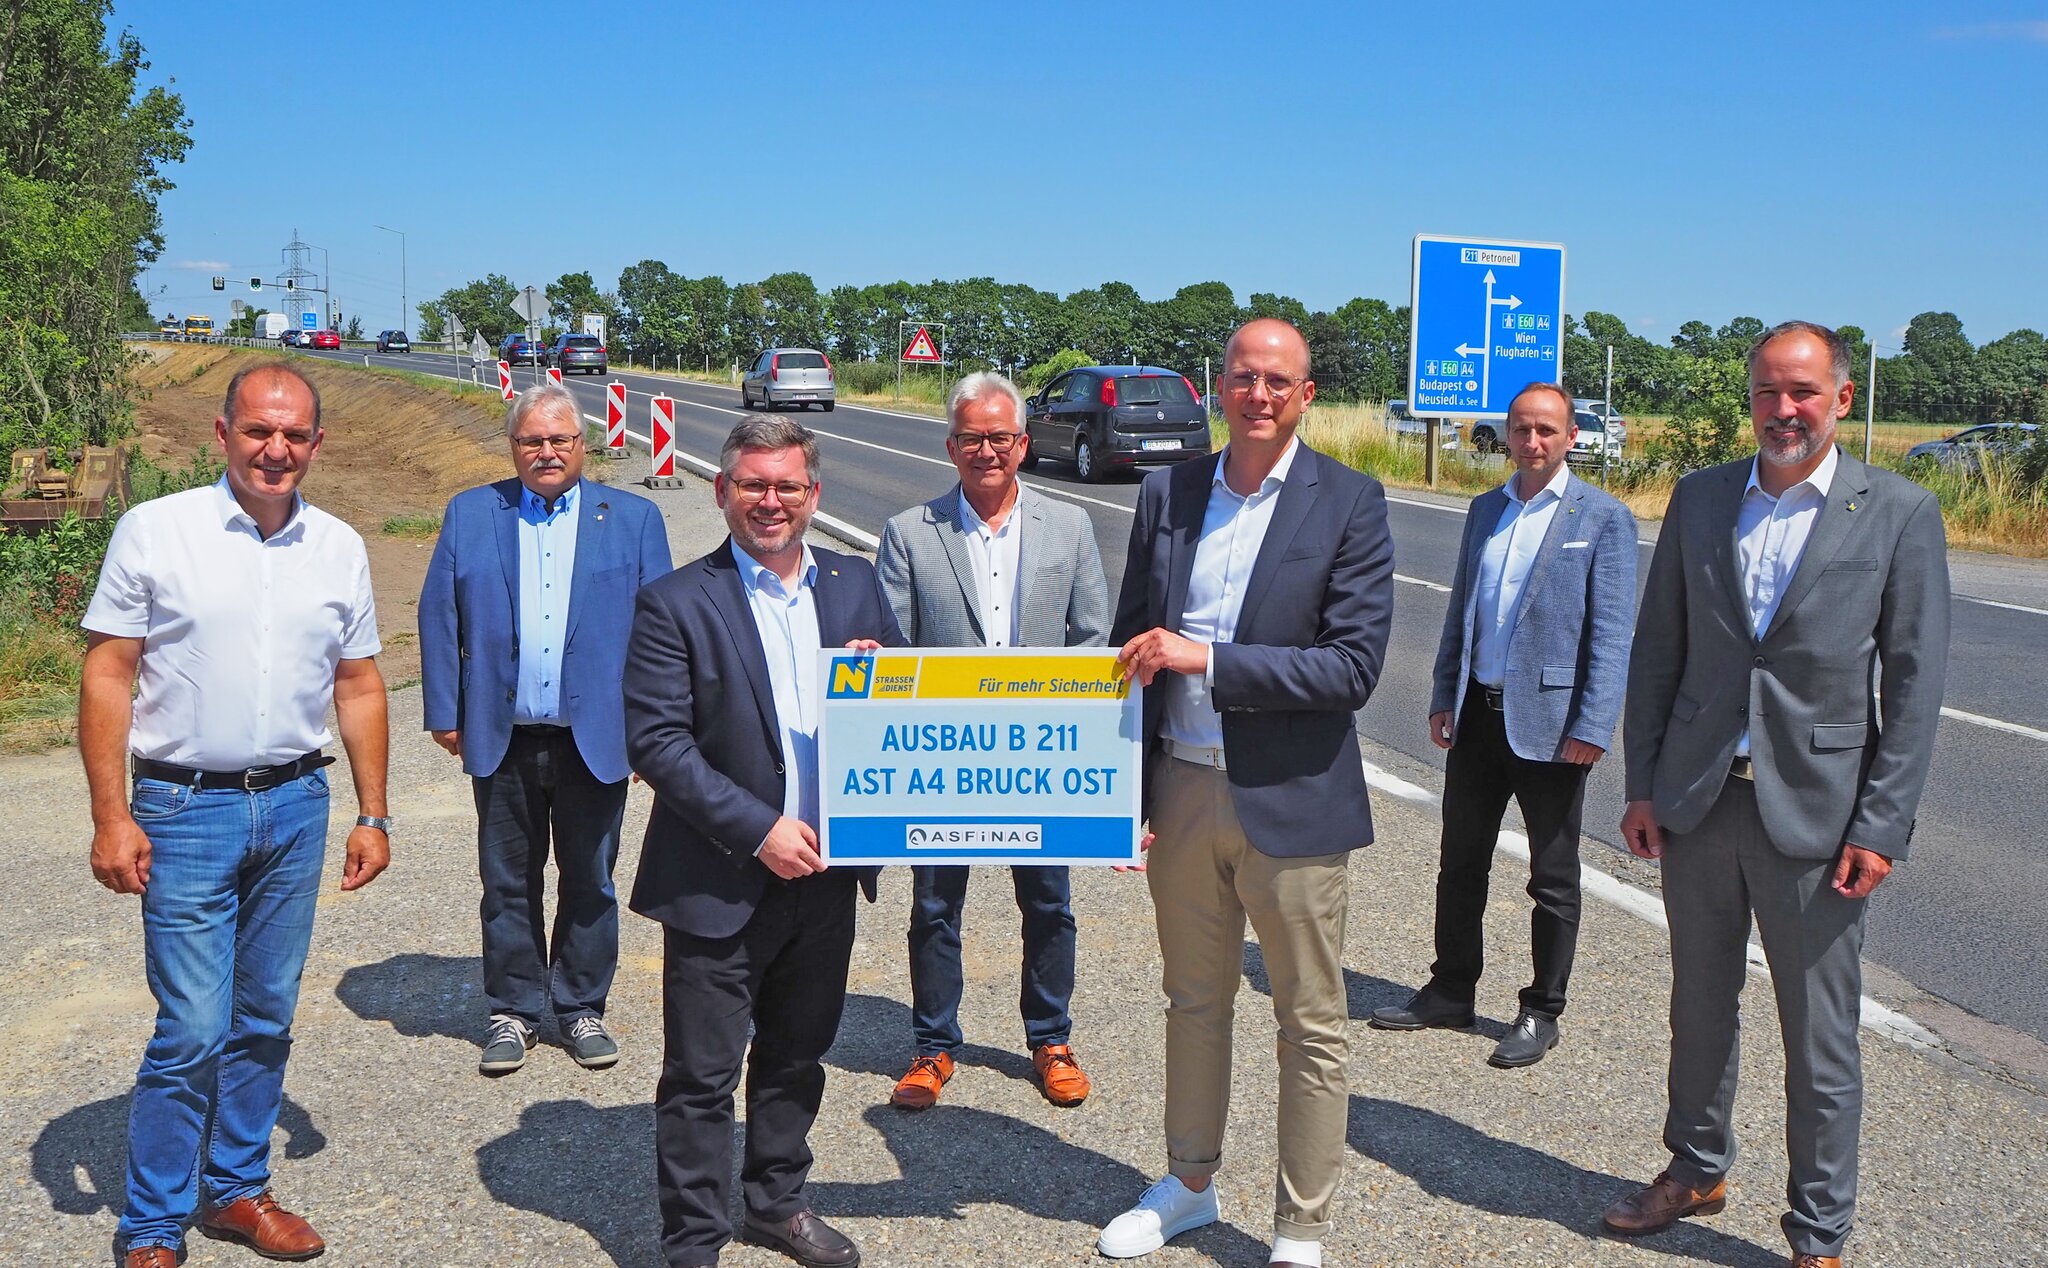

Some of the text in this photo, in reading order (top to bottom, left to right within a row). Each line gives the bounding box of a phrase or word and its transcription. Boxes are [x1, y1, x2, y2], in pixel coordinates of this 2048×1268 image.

[1465, 250, 1517, 264] 211 Petronell
[1519, 315, 1549, 329] E60 A4
[1515, 332, 1537, 344] Wien
[1495, 346, 1539, 360] Flughafen
[1442, 362, 1474, 376] E60 A4
[1420, 379, 1463, 392] Budapest
[1418, 393, 1458, 406] Neusiedl
[1466, 398, 1478, 407] See
[875, 675, 915, 685] STRASSEN
[978, 678, 1124, 693] Für mehr Sicherheit
[885, 684, 913, 692] DIENST
[881, 724, 1078, 751] AUSBAU B 211
[843, 768, 1117, 795] AST A4 BRUCK OST
